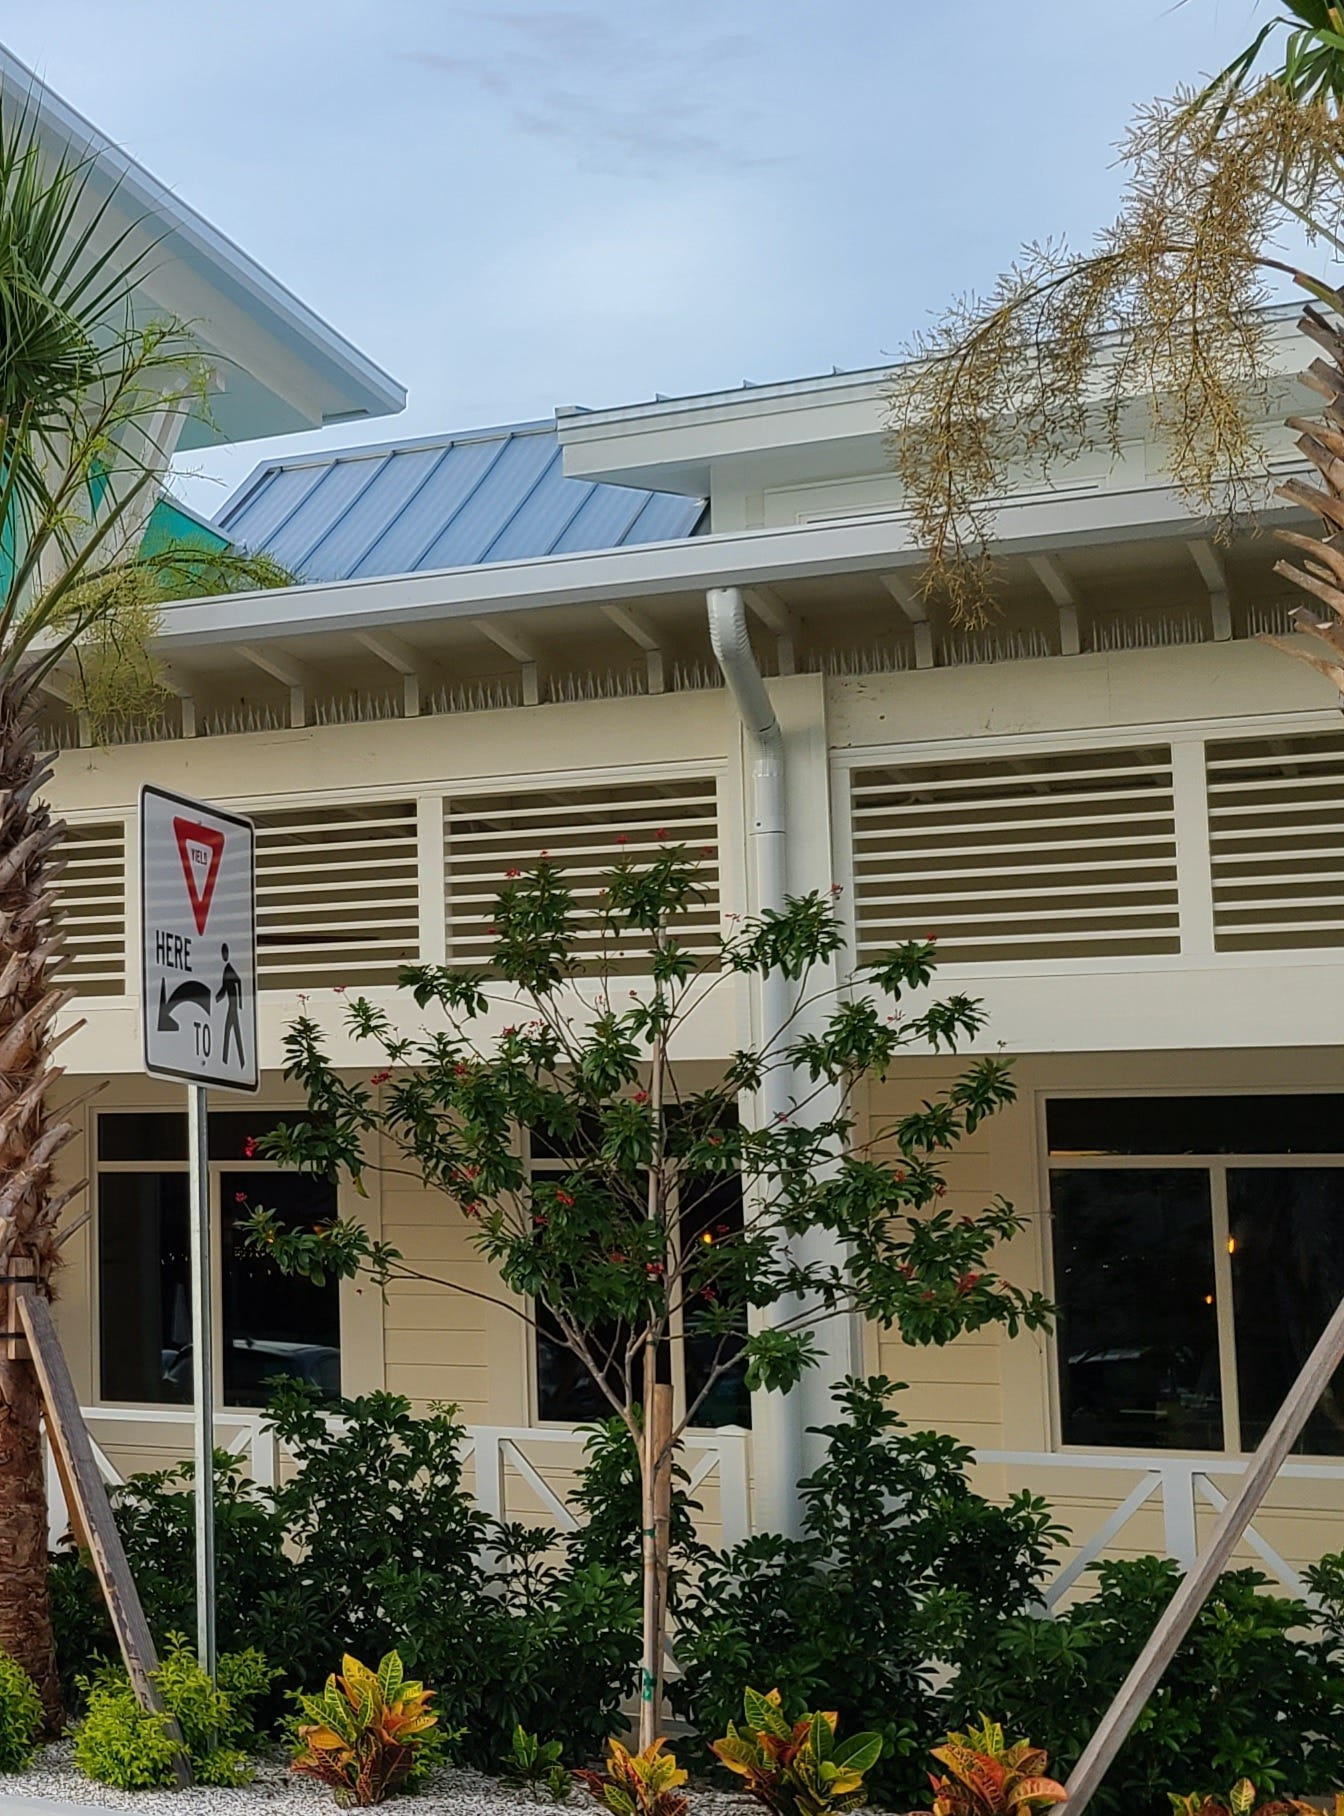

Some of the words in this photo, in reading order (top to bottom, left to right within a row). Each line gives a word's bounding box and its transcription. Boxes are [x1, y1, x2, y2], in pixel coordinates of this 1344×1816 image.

[191, 848, 208, 866] YIELD
[156, 930, 192, 972] HERE
[193, 1022, 211, 1057] TO
